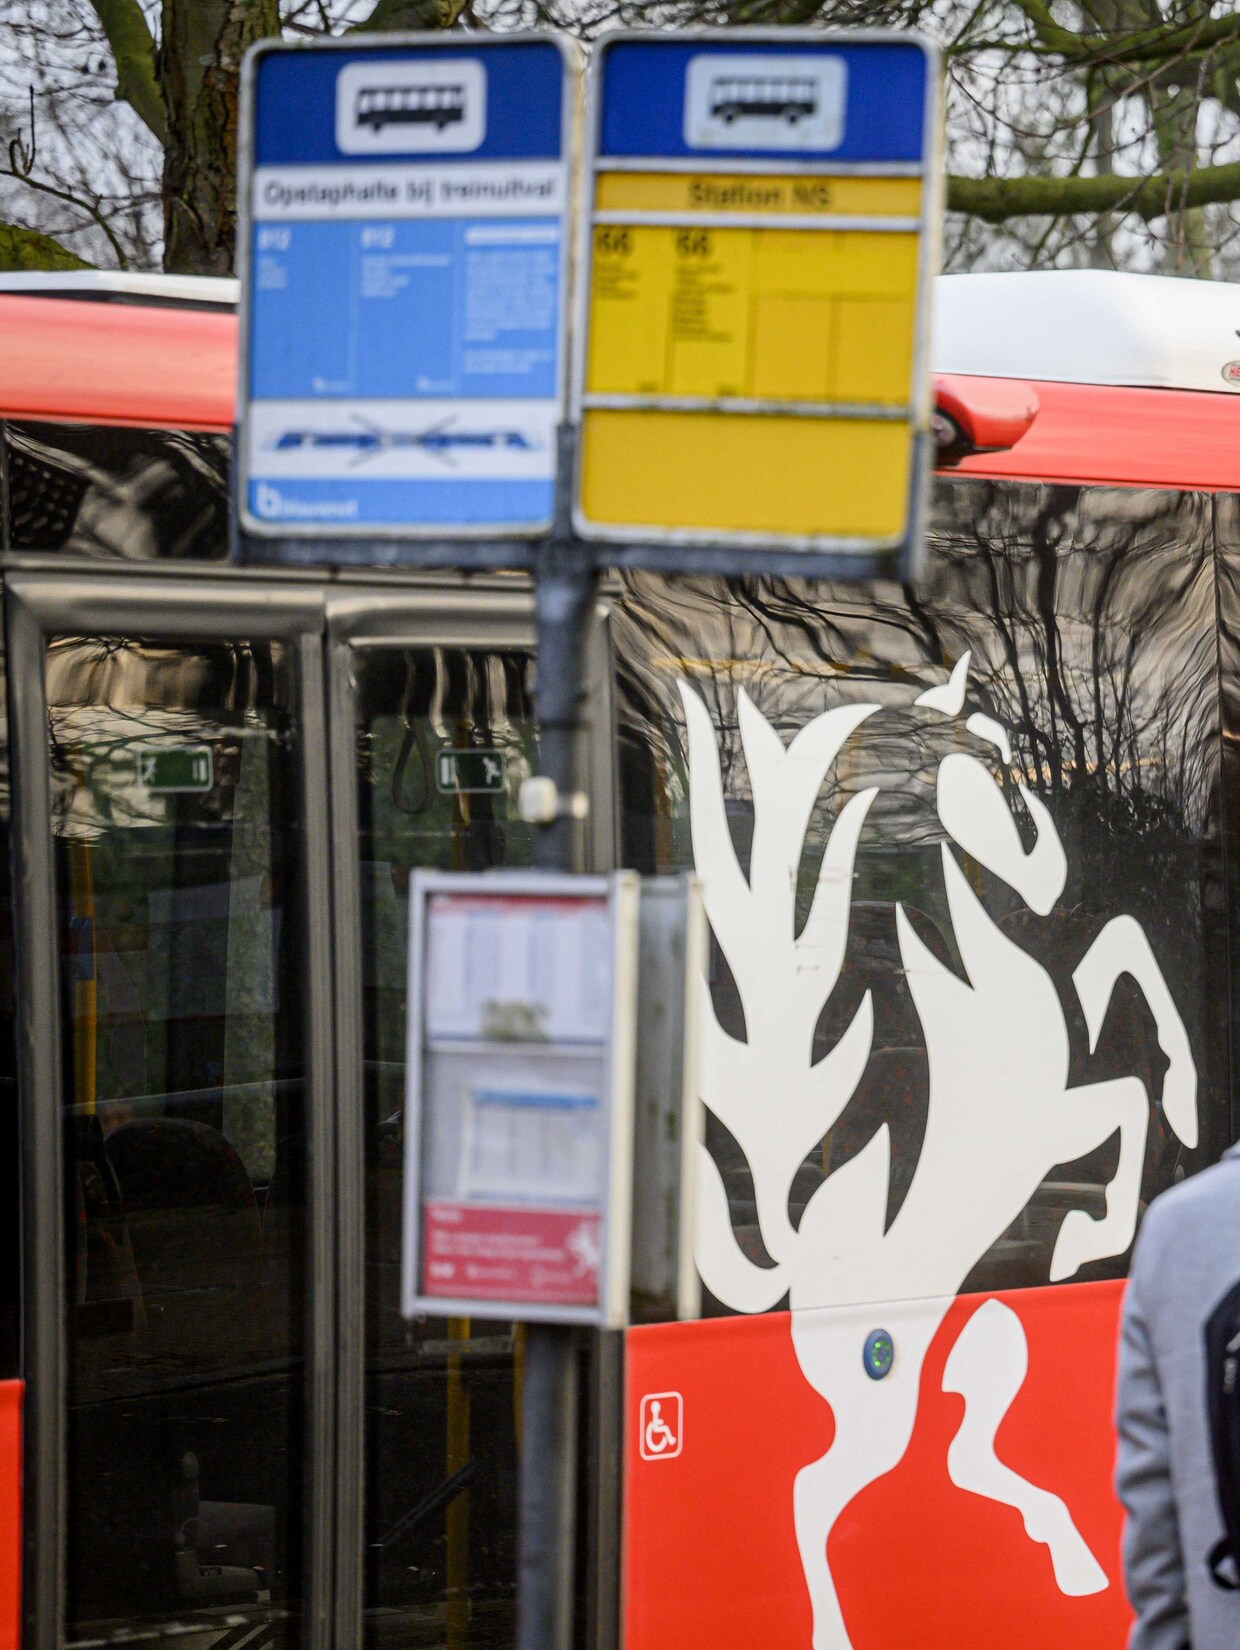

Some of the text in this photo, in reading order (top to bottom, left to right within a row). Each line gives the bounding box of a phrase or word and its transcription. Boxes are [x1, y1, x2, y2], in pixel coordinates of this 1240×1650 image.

[407, 178, 433, 207] bij
[688, 179, 831, 208] Station NS
